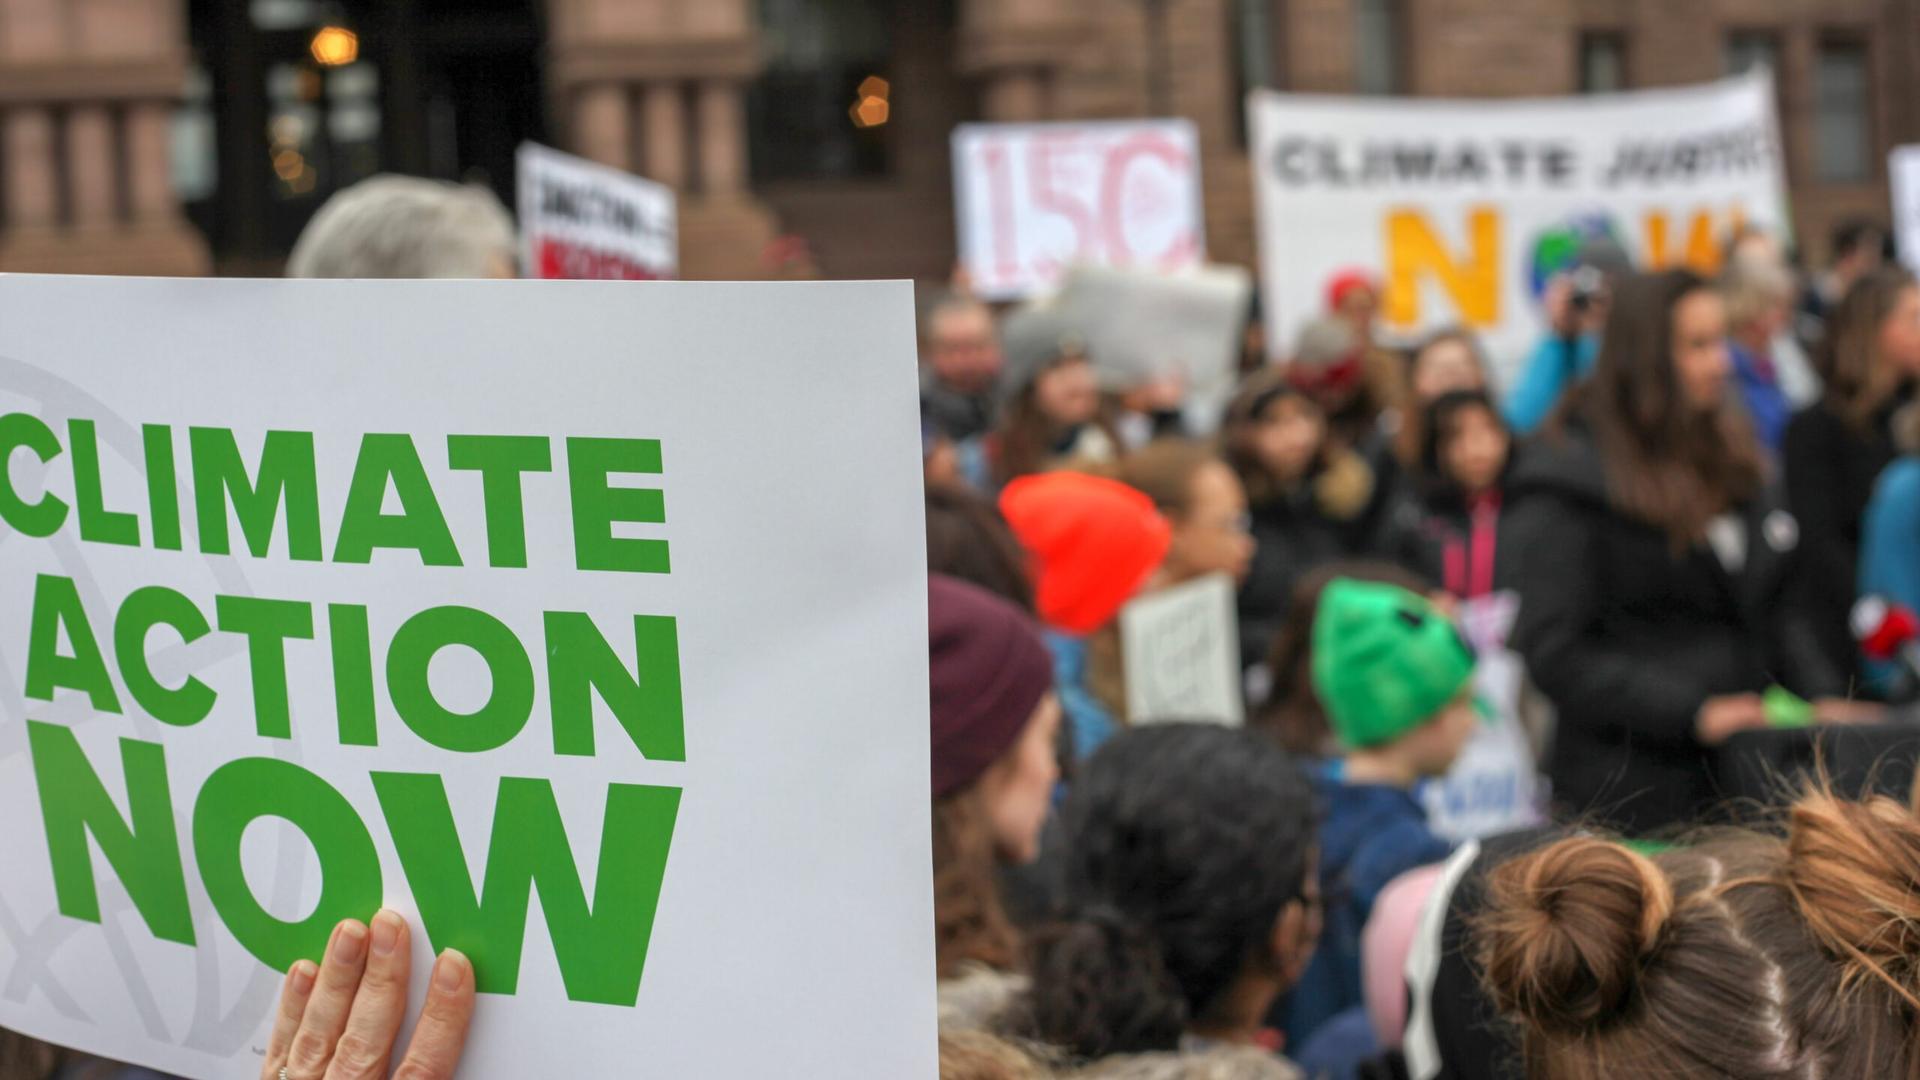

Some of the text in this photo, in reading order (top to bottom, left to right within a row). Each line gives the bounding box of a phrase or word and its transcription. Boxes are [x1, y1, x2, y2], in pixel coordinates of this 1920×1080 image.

[1272, 136, 1577, 188] CLIMATE
[0, 413, 671, 573] CLIMATE
[26, 574, 686, 762] ACTION
[28, 720, 686, 1007] NOW
